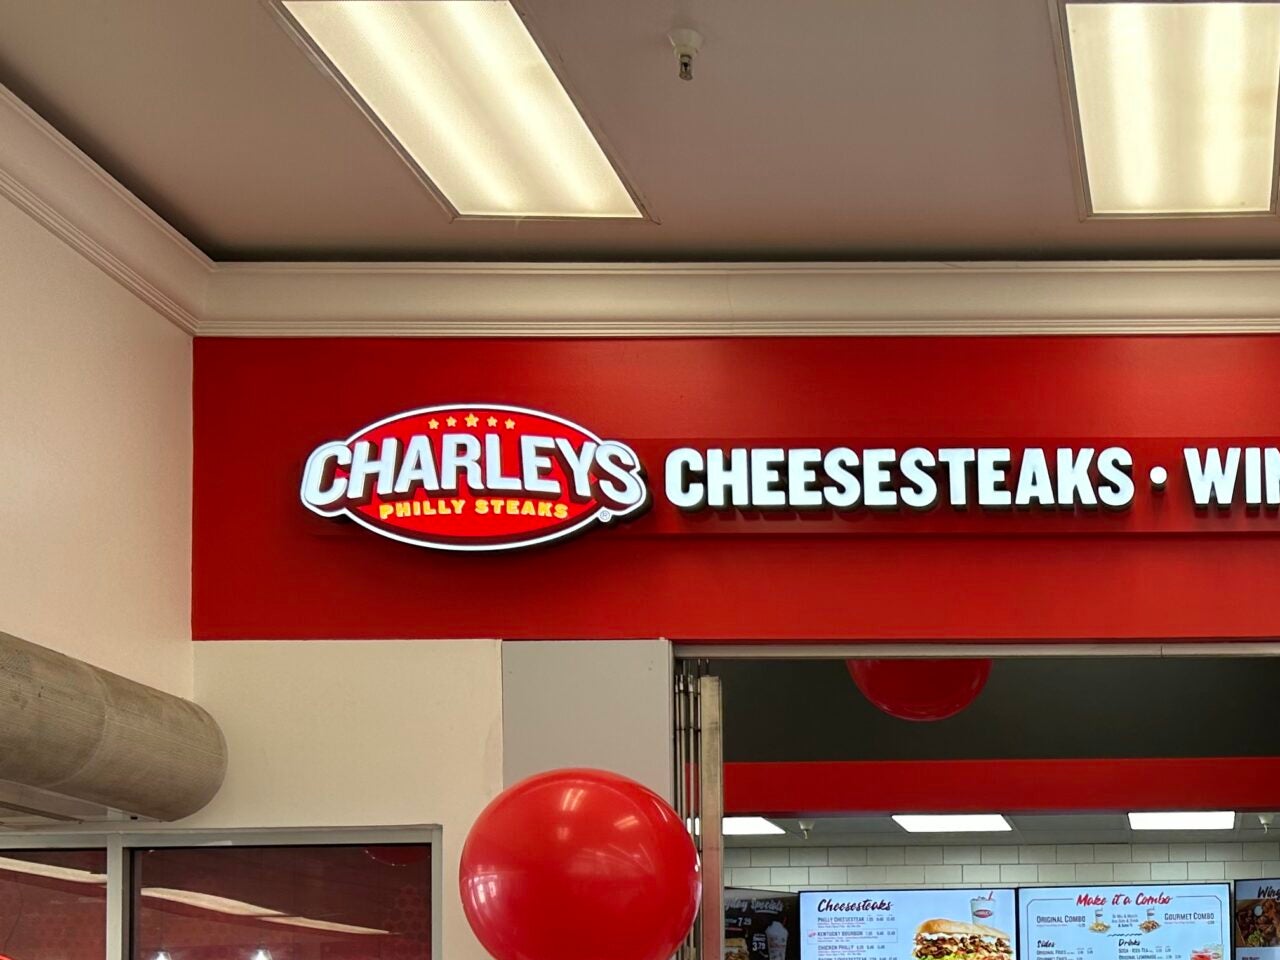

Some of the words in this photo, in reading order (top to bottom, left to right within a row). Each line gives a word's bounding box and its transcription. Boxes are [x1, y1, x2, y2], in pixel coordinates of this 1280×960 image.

[301, 433, 642, 504] CHARLEYS
[665, 447, 1135, 507] CHEESESTEAKS
[379, 499, 466, 520] PHILLY
[475, 498, 569, 519] STEAKS
[817, 899, 893, 912] Cheesesteaks
[1076, 894, 1107, 906] Make
[1135, 892, 1173, 906] Combo
